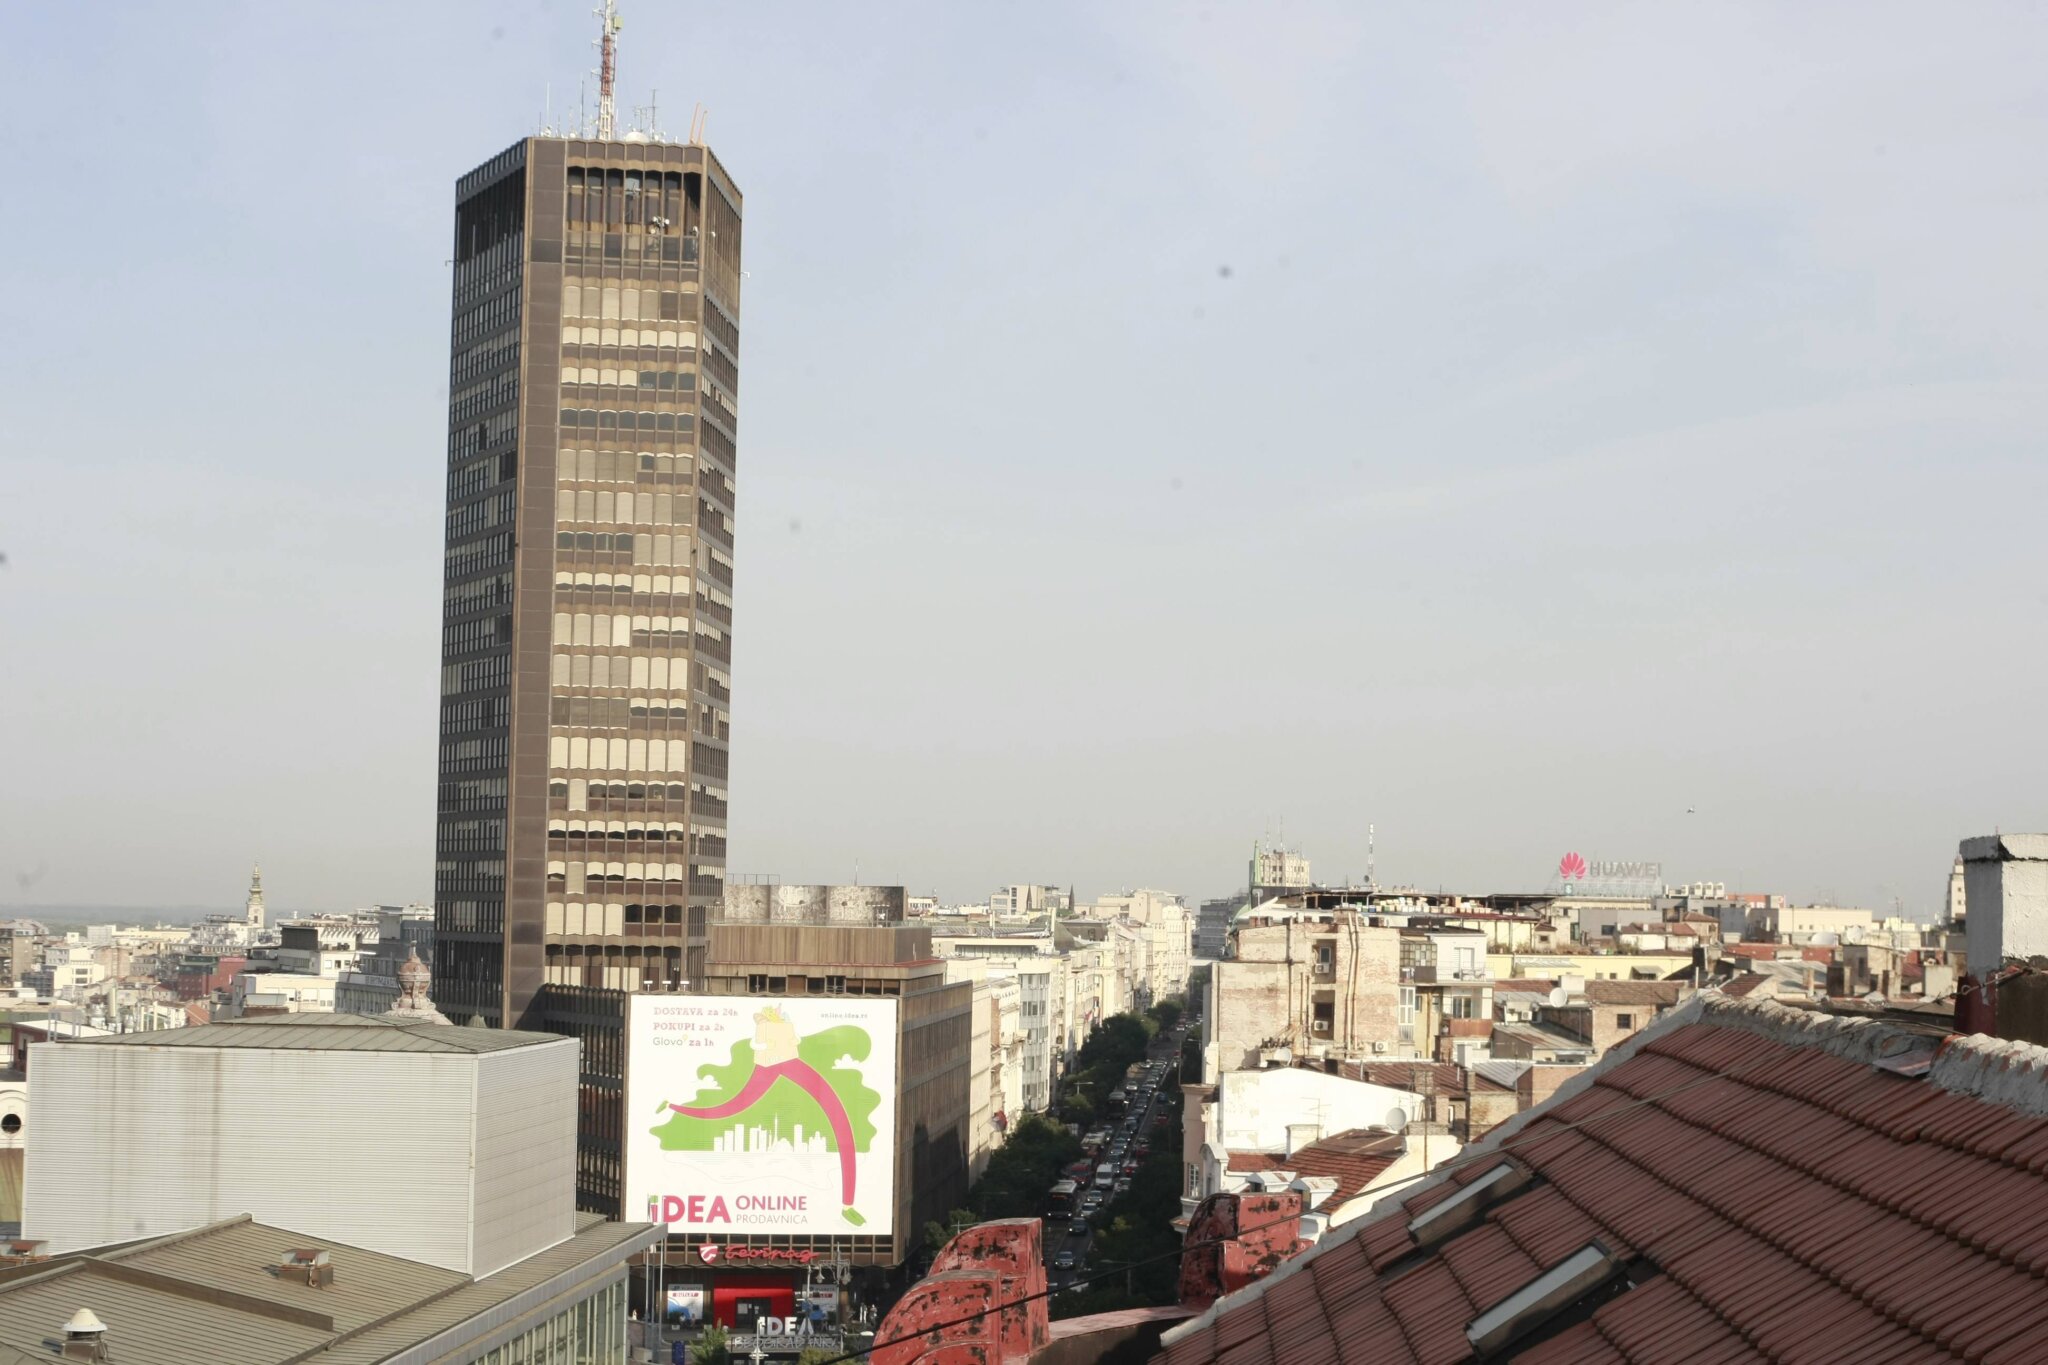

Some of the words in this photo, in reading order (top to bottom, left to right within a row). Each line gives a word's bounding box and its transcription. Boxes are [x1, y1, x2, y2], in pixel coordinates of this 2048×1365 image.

[1590, 862, 1662, 877] HUAWEI
[653, 1007, 703, 1016] DOSTAVA
[722, 1008, 739, 1017] 24h
[653, 1022, 695, 1031] POKUPI
[713, 1023, 725, 1031] 2h
[652, 1037, 683, 1046] Glovo
[704, 1038, 714, 1047] 1h
[735, 1195, 808, 1211] ONLINE
[736, 1214, 808, 1224] PRODAVNICA
